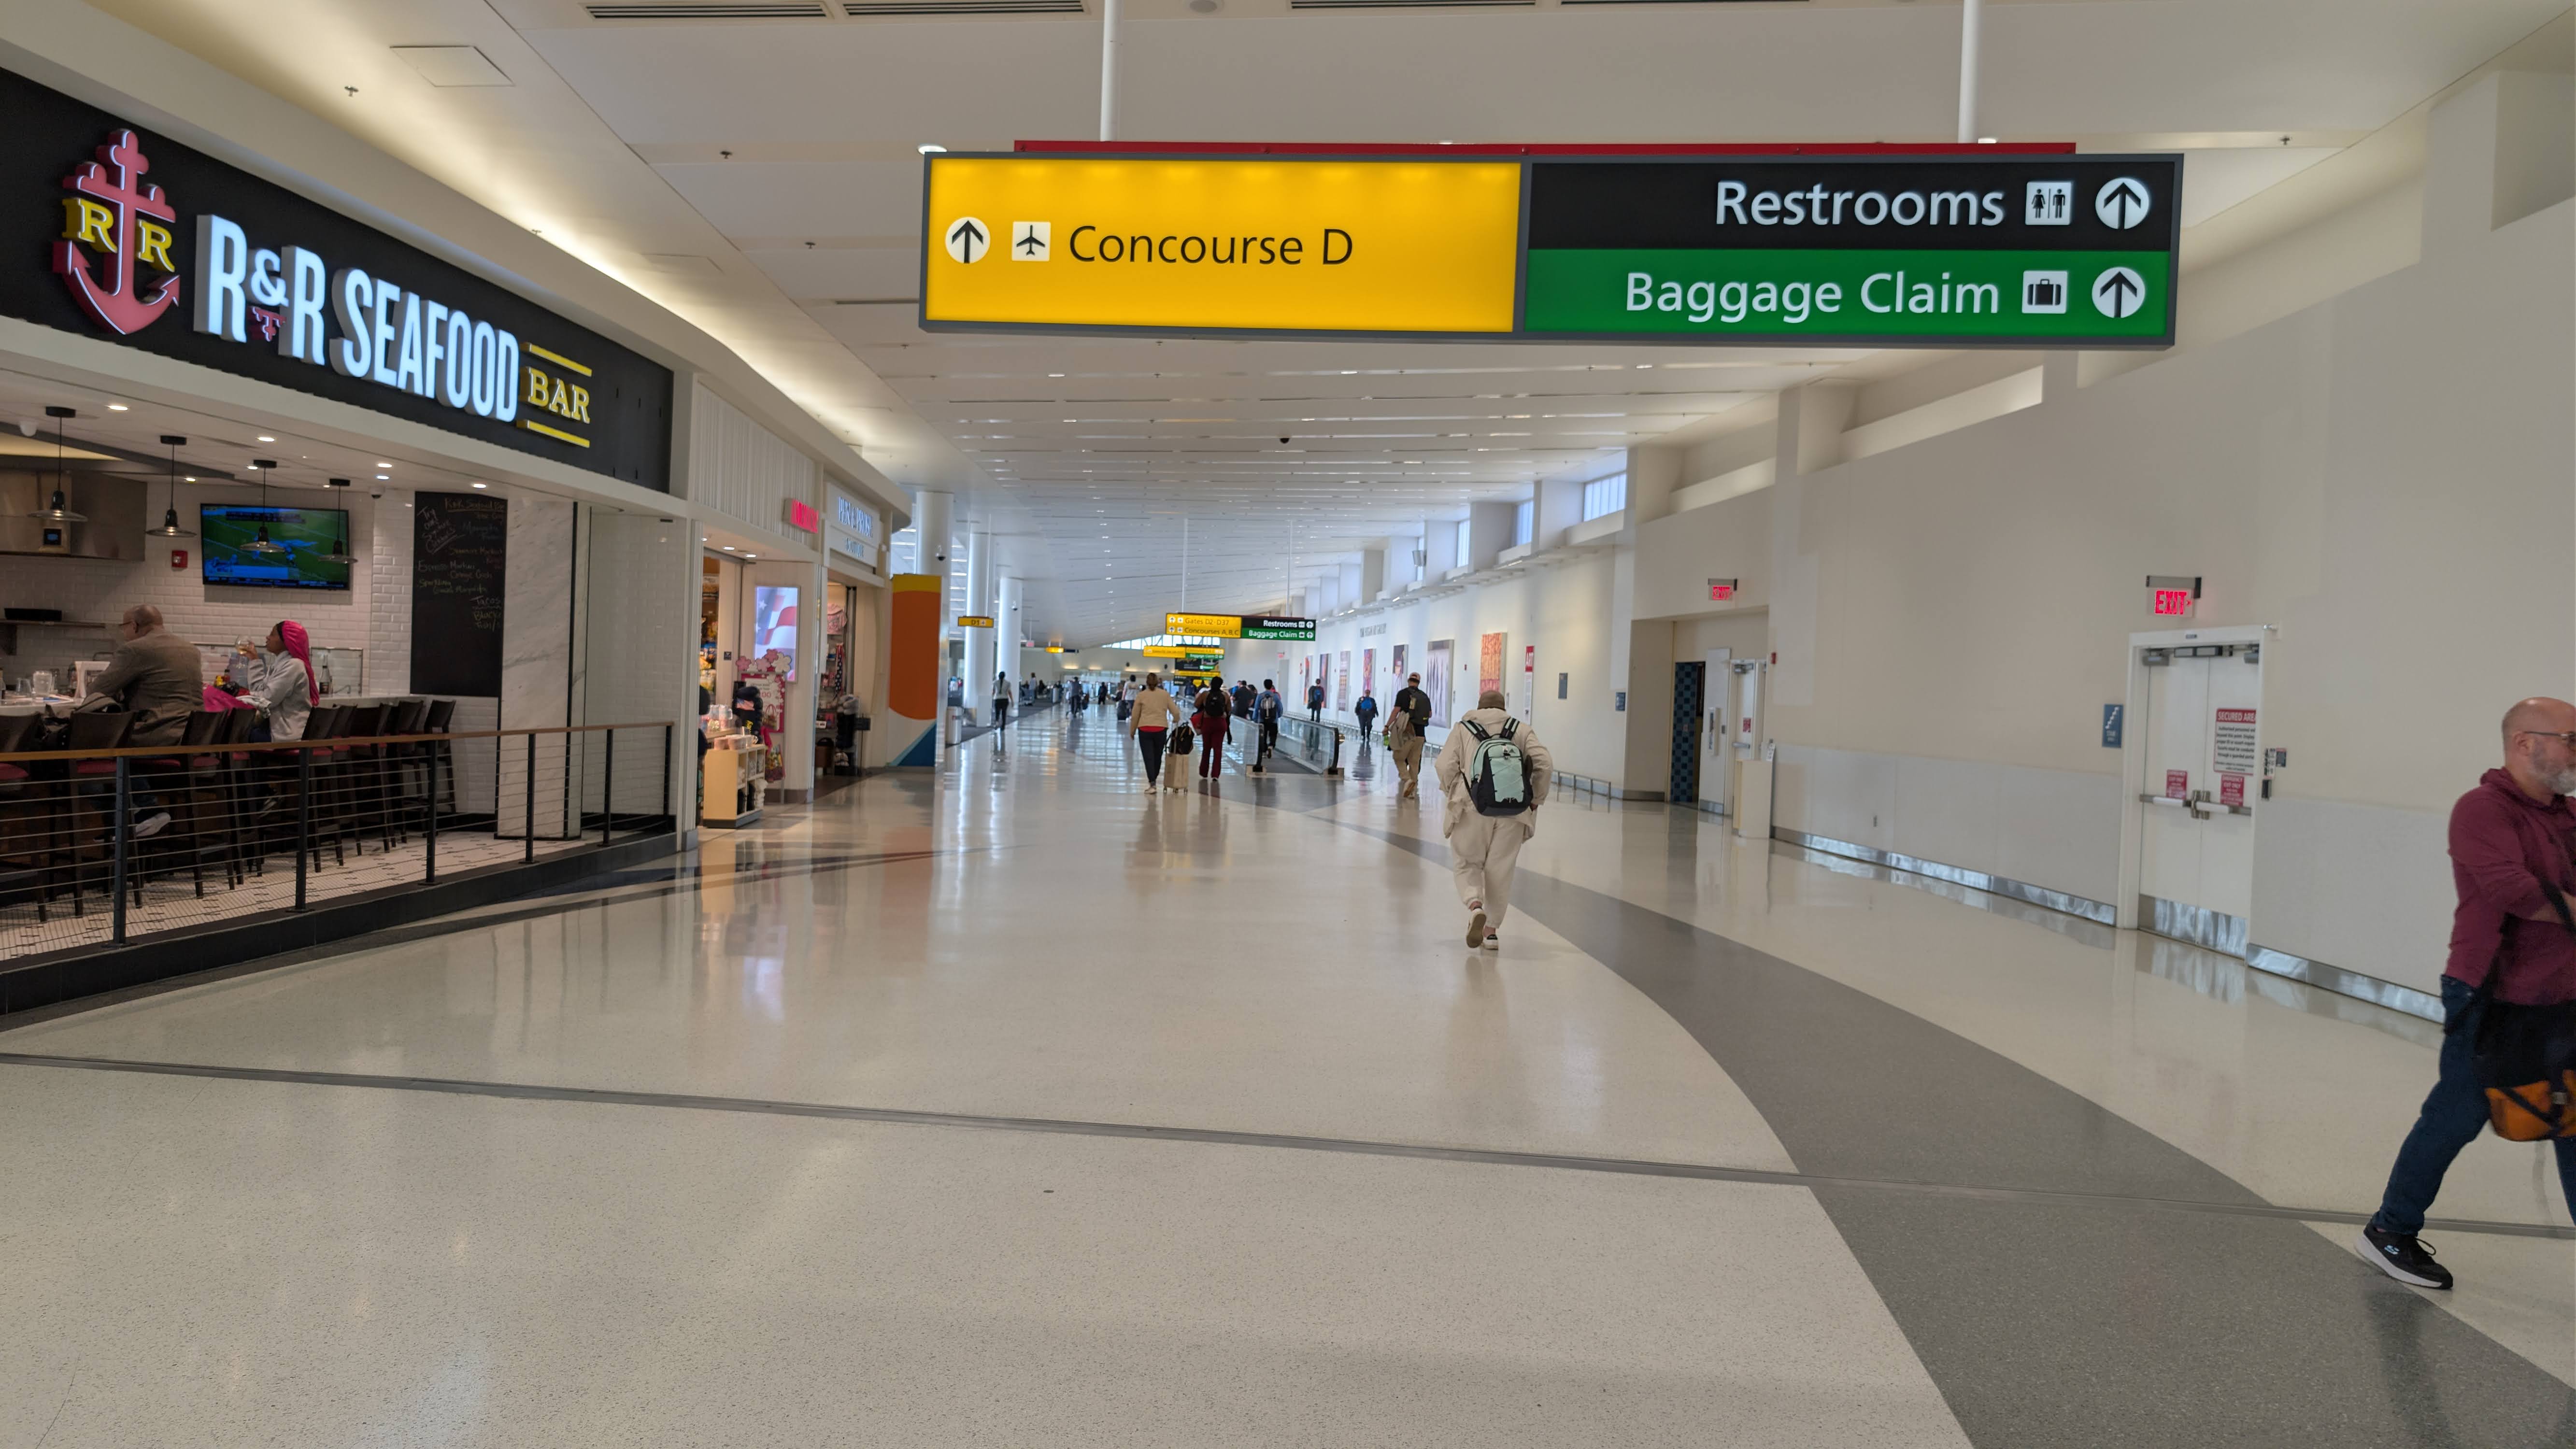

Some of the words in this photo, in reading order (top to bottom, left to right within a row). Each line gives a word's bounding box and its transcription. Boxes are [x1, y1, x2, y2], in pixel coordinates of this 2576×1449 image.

[1716, 180, 2006, 226] Restrooms
[62, 197, 117, 253] R
[137, 219, 175, 272] R
[1069, 226, 1303, 265] Concourse
[1322, 228, 1353, 265] D
[1626, 272, 1842, 324] Baggage
[1860, 270, 2000, 314] Claim
[194, 214, 326, 366] R&R
[330, 267, 520, 423] SEAFOOD
[518, 366, 590, 424] BAR
[2155, 590, 2187, 615] EXIT
[1249, 630, 1278, 639] Baggage
[1263, 620, 1297, 628] Restrooms
[2218, 711, 2242, 721] SECURED
